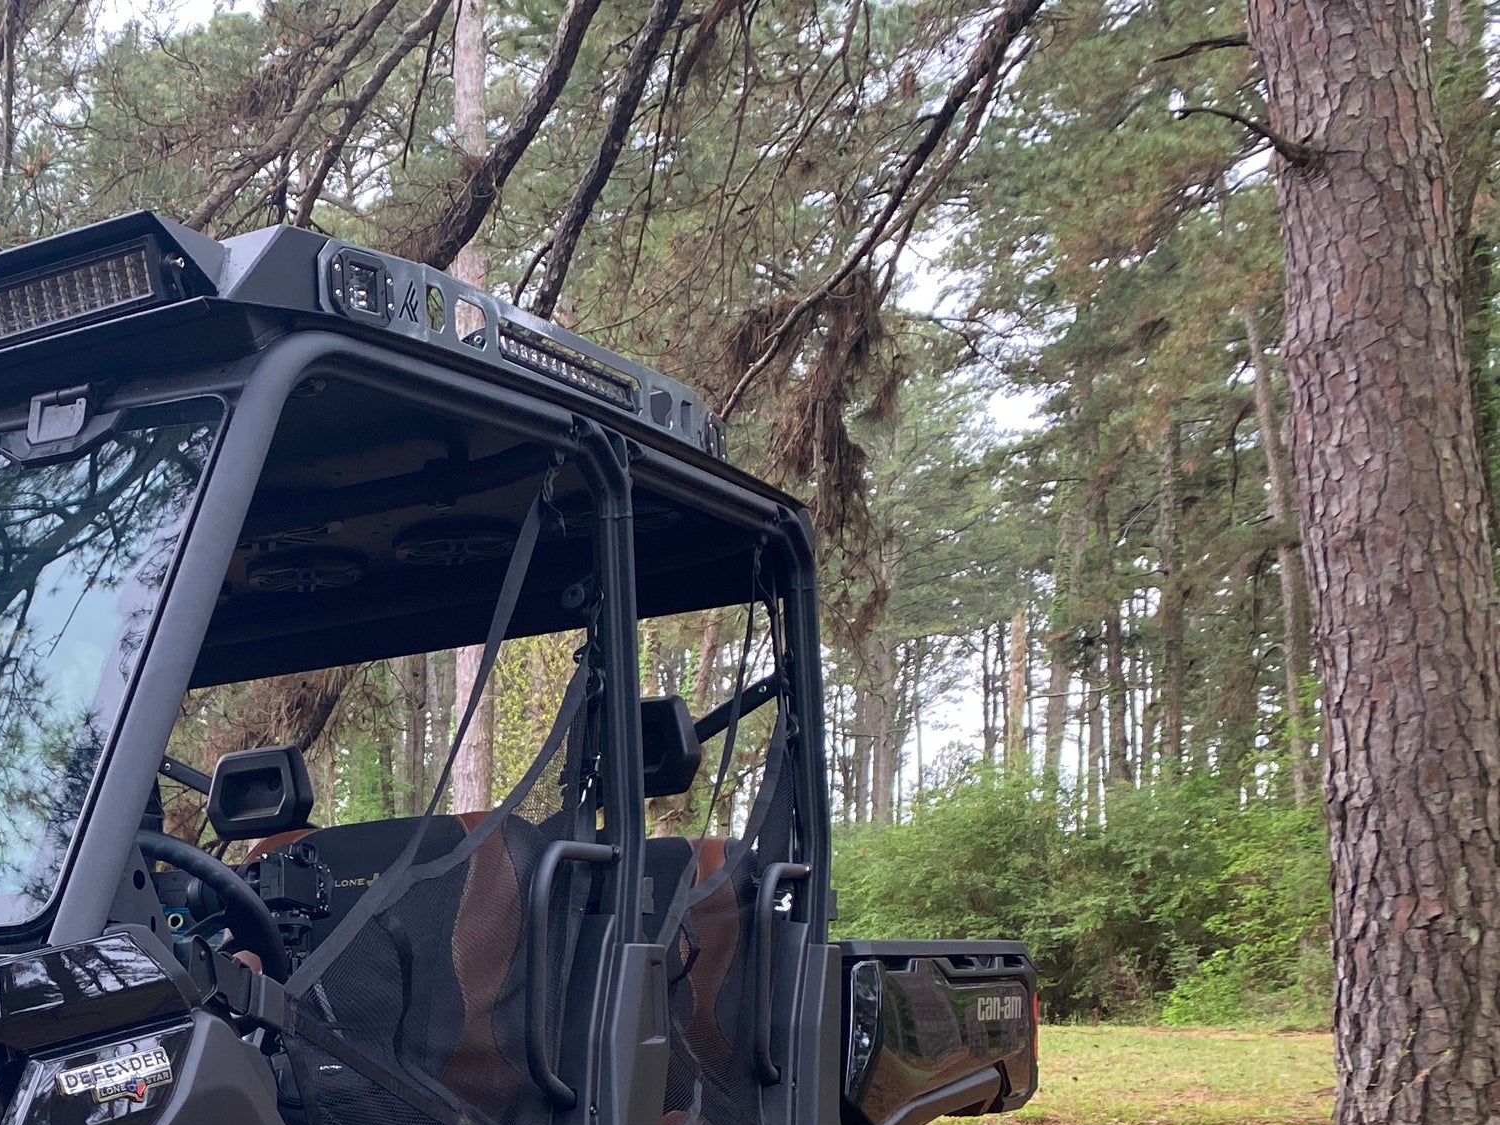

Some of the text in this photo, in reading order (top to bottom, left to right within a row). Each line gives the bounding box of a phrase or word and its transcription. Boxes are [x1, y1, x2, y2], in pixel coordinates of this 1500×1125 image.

[334, 878, 366, 888] LONE
[977, 996, 1021, 1021] can-am
[64, 1050, 167, 1089] DEFENDER
[101, 1072, 170, 1097] LONE STAR
